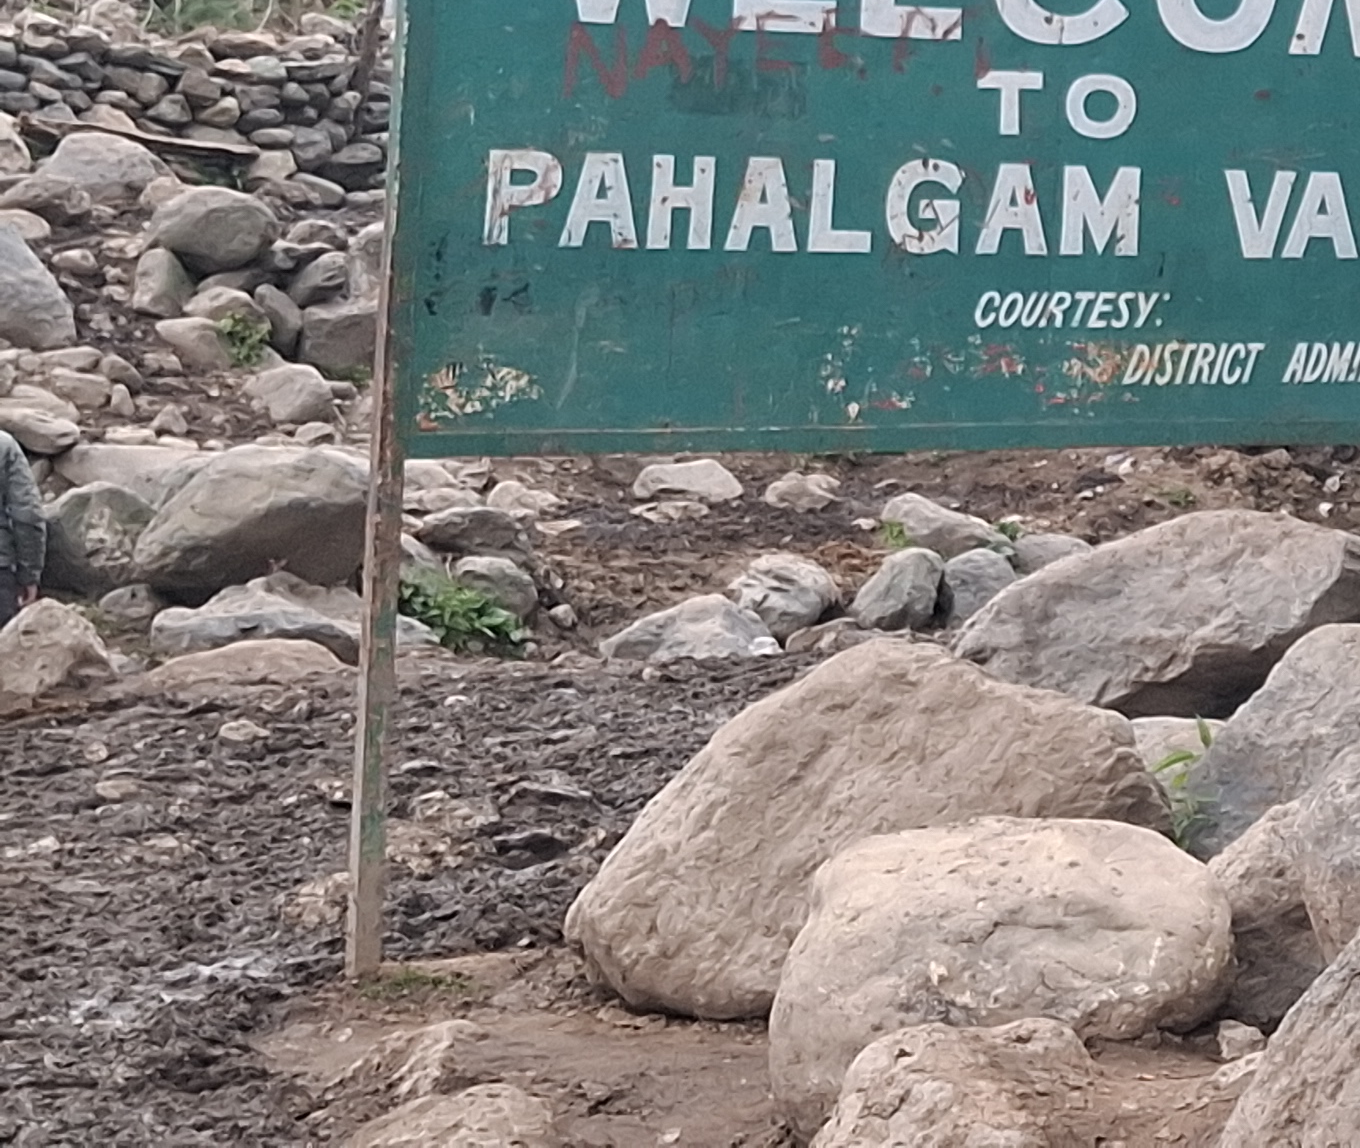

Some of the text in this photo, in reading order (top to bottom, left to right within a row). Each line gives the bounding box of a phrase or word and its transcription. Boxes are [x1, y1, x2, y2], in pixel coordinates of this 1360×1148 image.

[976, 70, 1137, 139] TO
[483, 148, 1141, 257] PAHALGAM
[973, 291, 1171, 329] COURTESY:
[1121, 342, 1266, 386] DISTRICT
